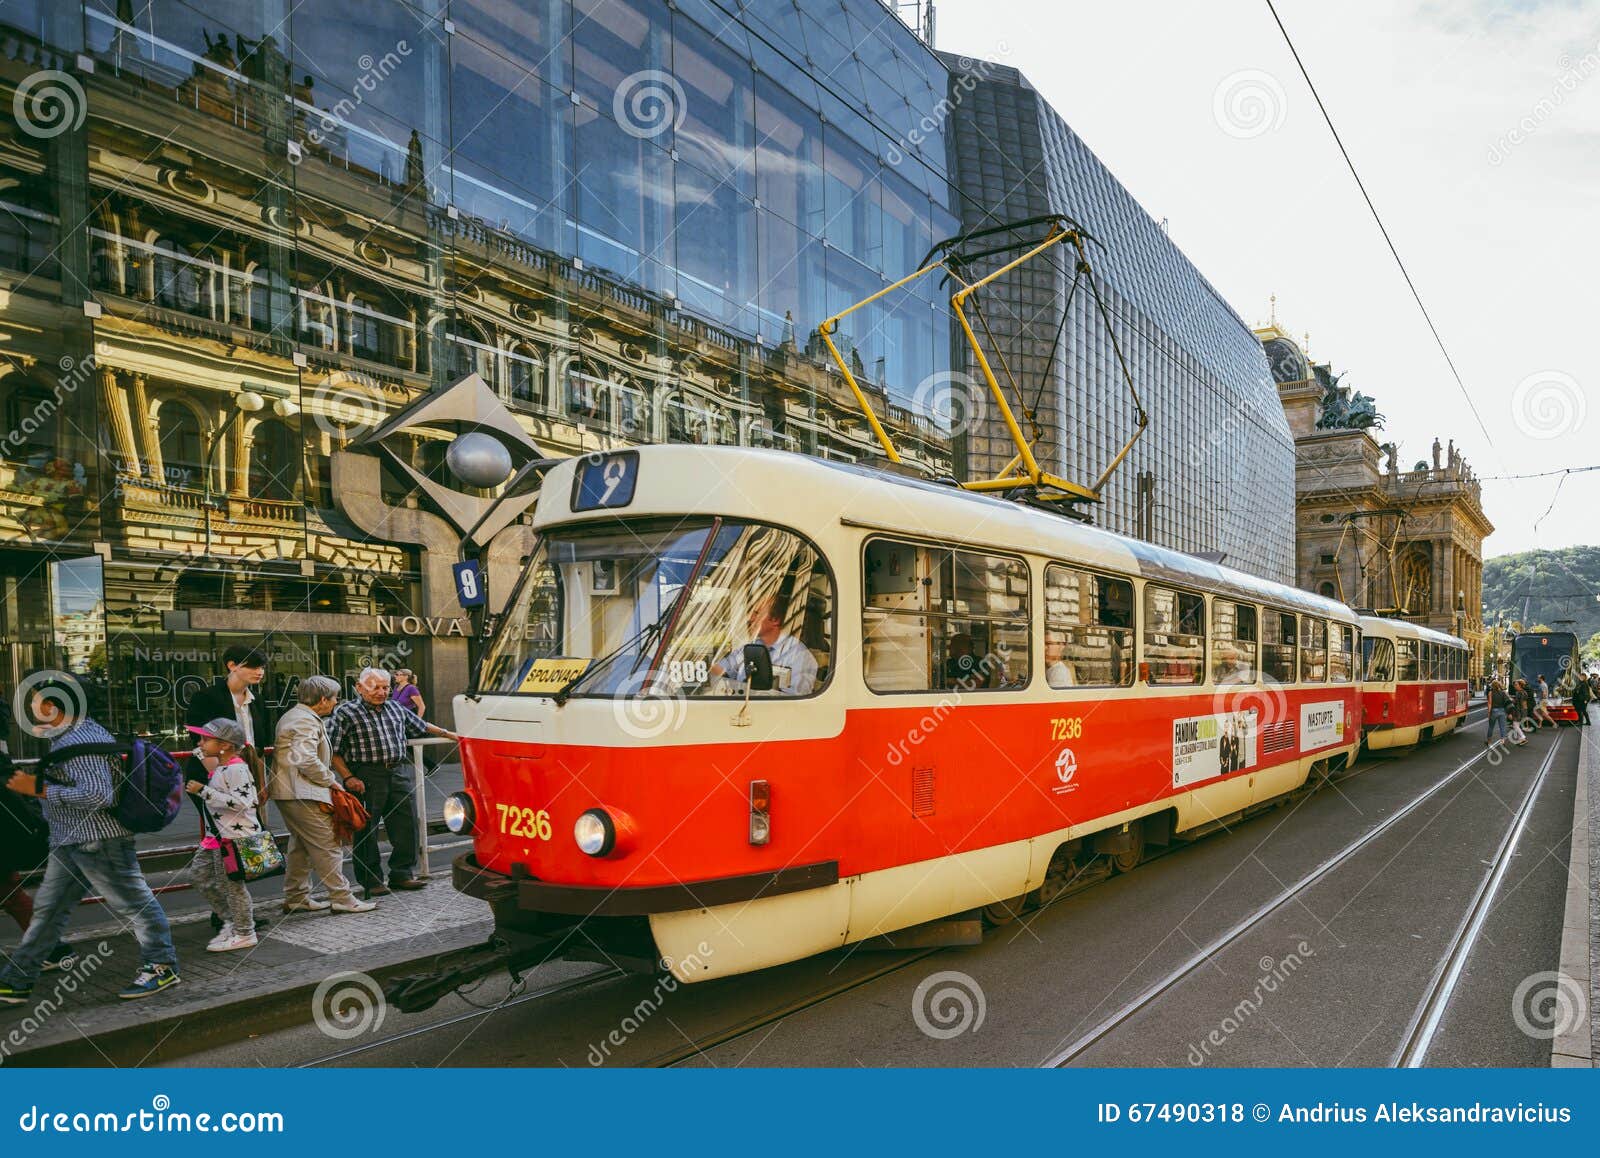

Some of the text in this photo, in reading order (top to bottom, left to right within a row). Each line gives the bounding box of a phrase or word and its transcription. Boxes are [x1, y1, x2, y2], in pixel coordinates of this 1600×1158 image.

[116, 460, 191, 482] LEGENDY
[599, 456, 626, 505] 9
[460, 568, 478, 600] 9
[134, 647, 217, 662] Národní
[669, 659, 709, 684] 808
[1050, 717, 1082, 741] 7236
[495, 803, 552, 842] 7236
